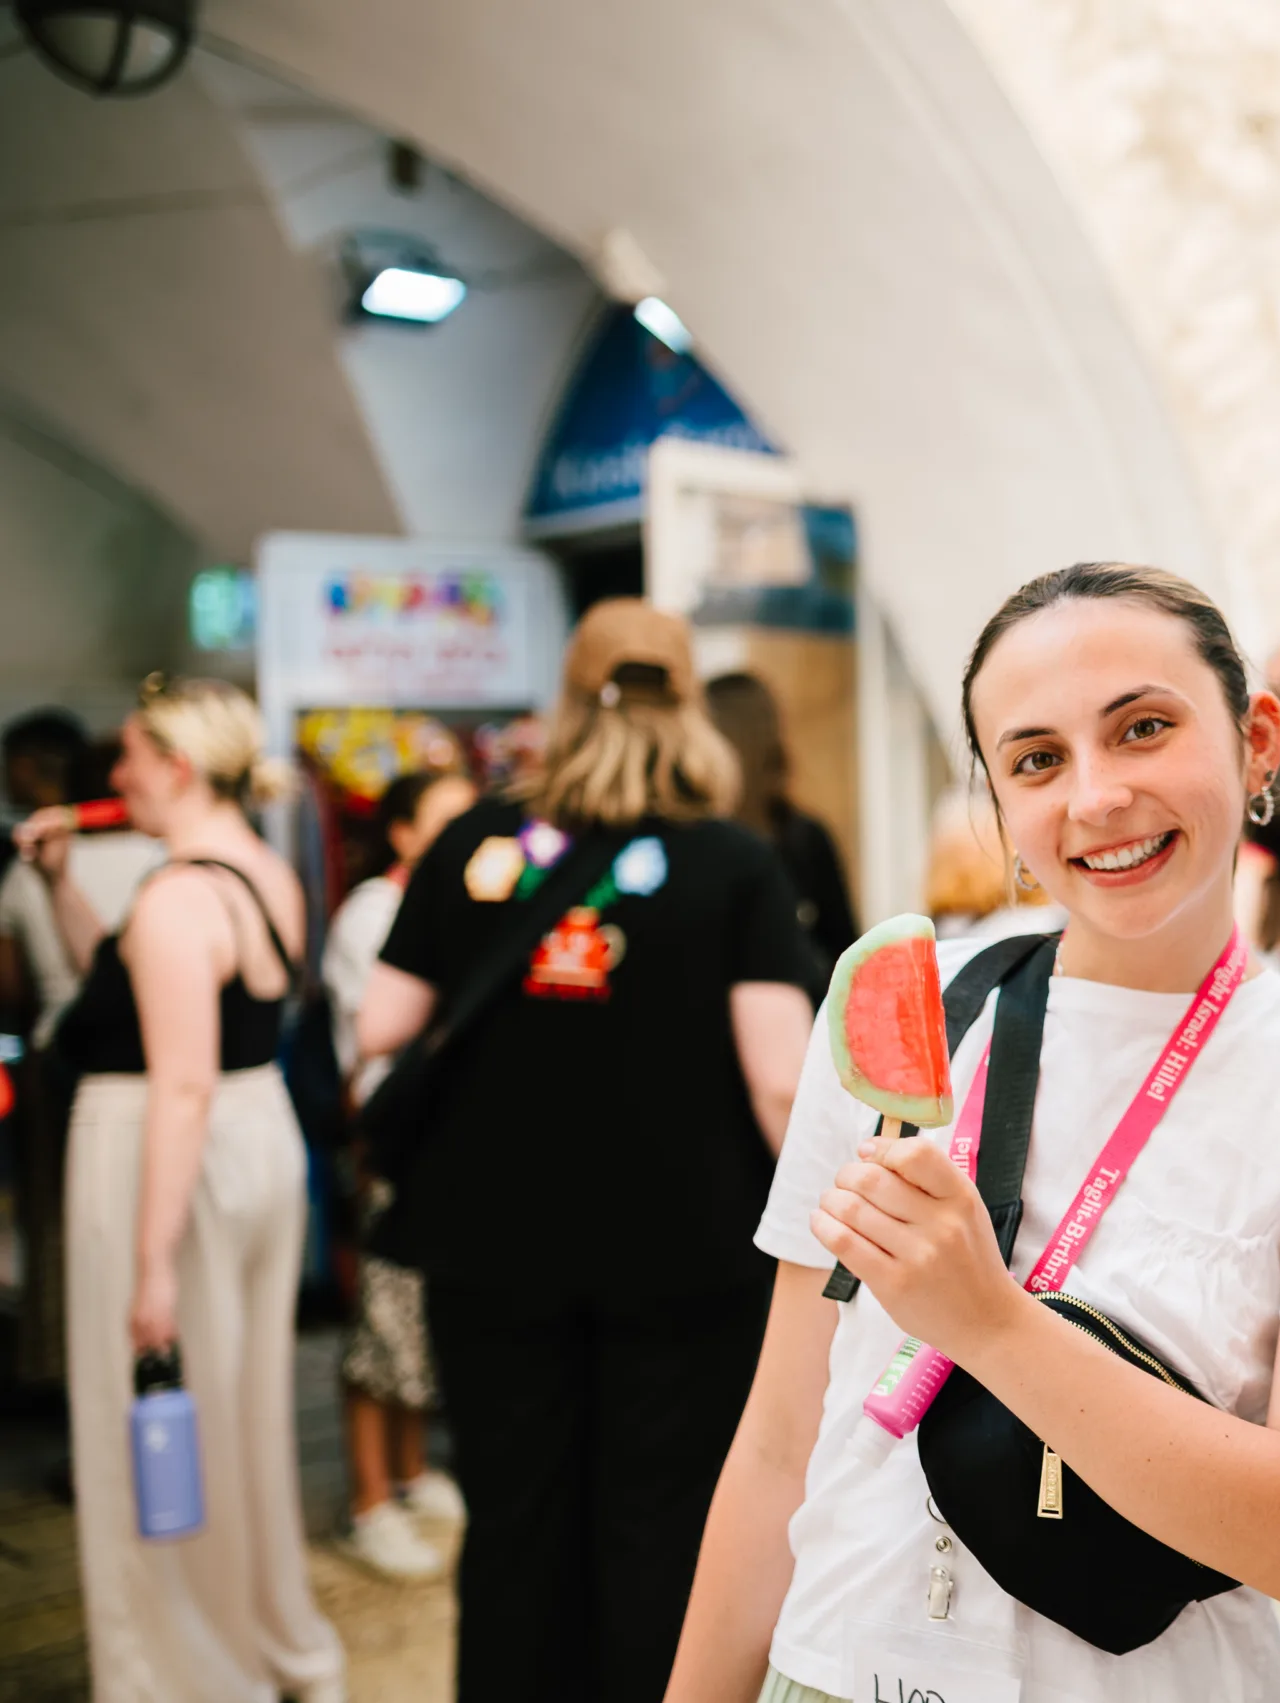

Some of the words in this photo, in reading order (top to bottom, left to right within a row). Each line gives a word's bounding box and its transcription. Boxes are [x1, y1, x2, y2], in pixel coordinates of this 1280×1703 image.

[1175, 998, 1220, 1051] Israel:
[1146, 1049, 1189, 1102] Hillel
[1030, 1167, 1121, 1292] Taglit-Birthrig
